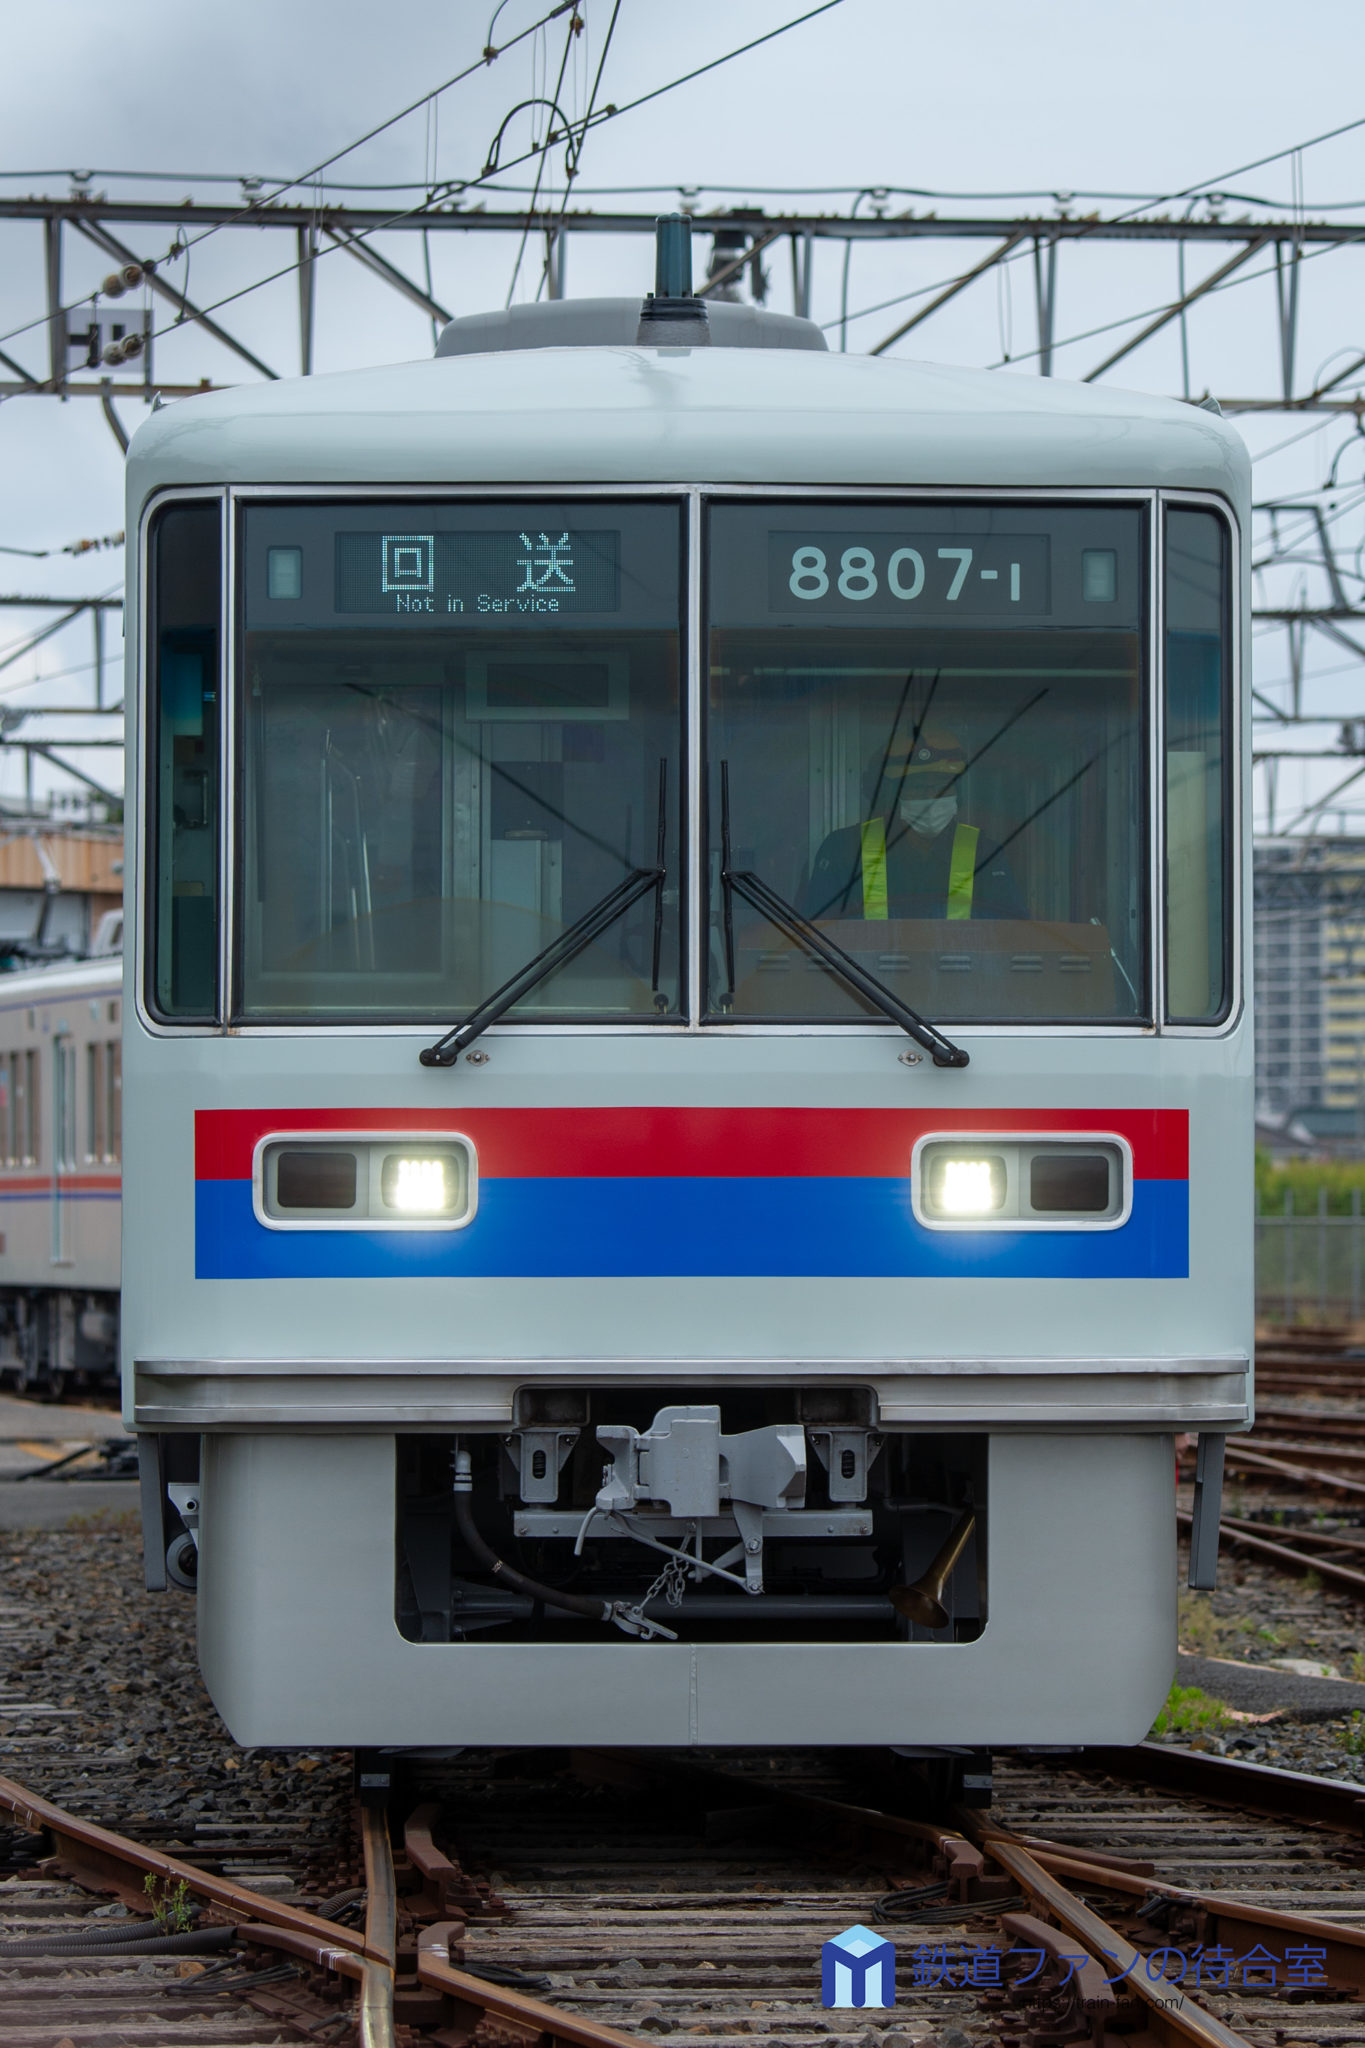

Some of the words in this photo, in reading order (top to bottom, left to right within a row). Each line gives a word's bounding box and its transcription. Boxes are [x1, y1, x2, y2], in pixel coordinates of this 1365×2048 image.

[789, 546, 1020, 601] 8807-1
[396, 594, 434, 612] Not
[447, 594, 464, 612] in
[477, 594, 559, 612] Service
